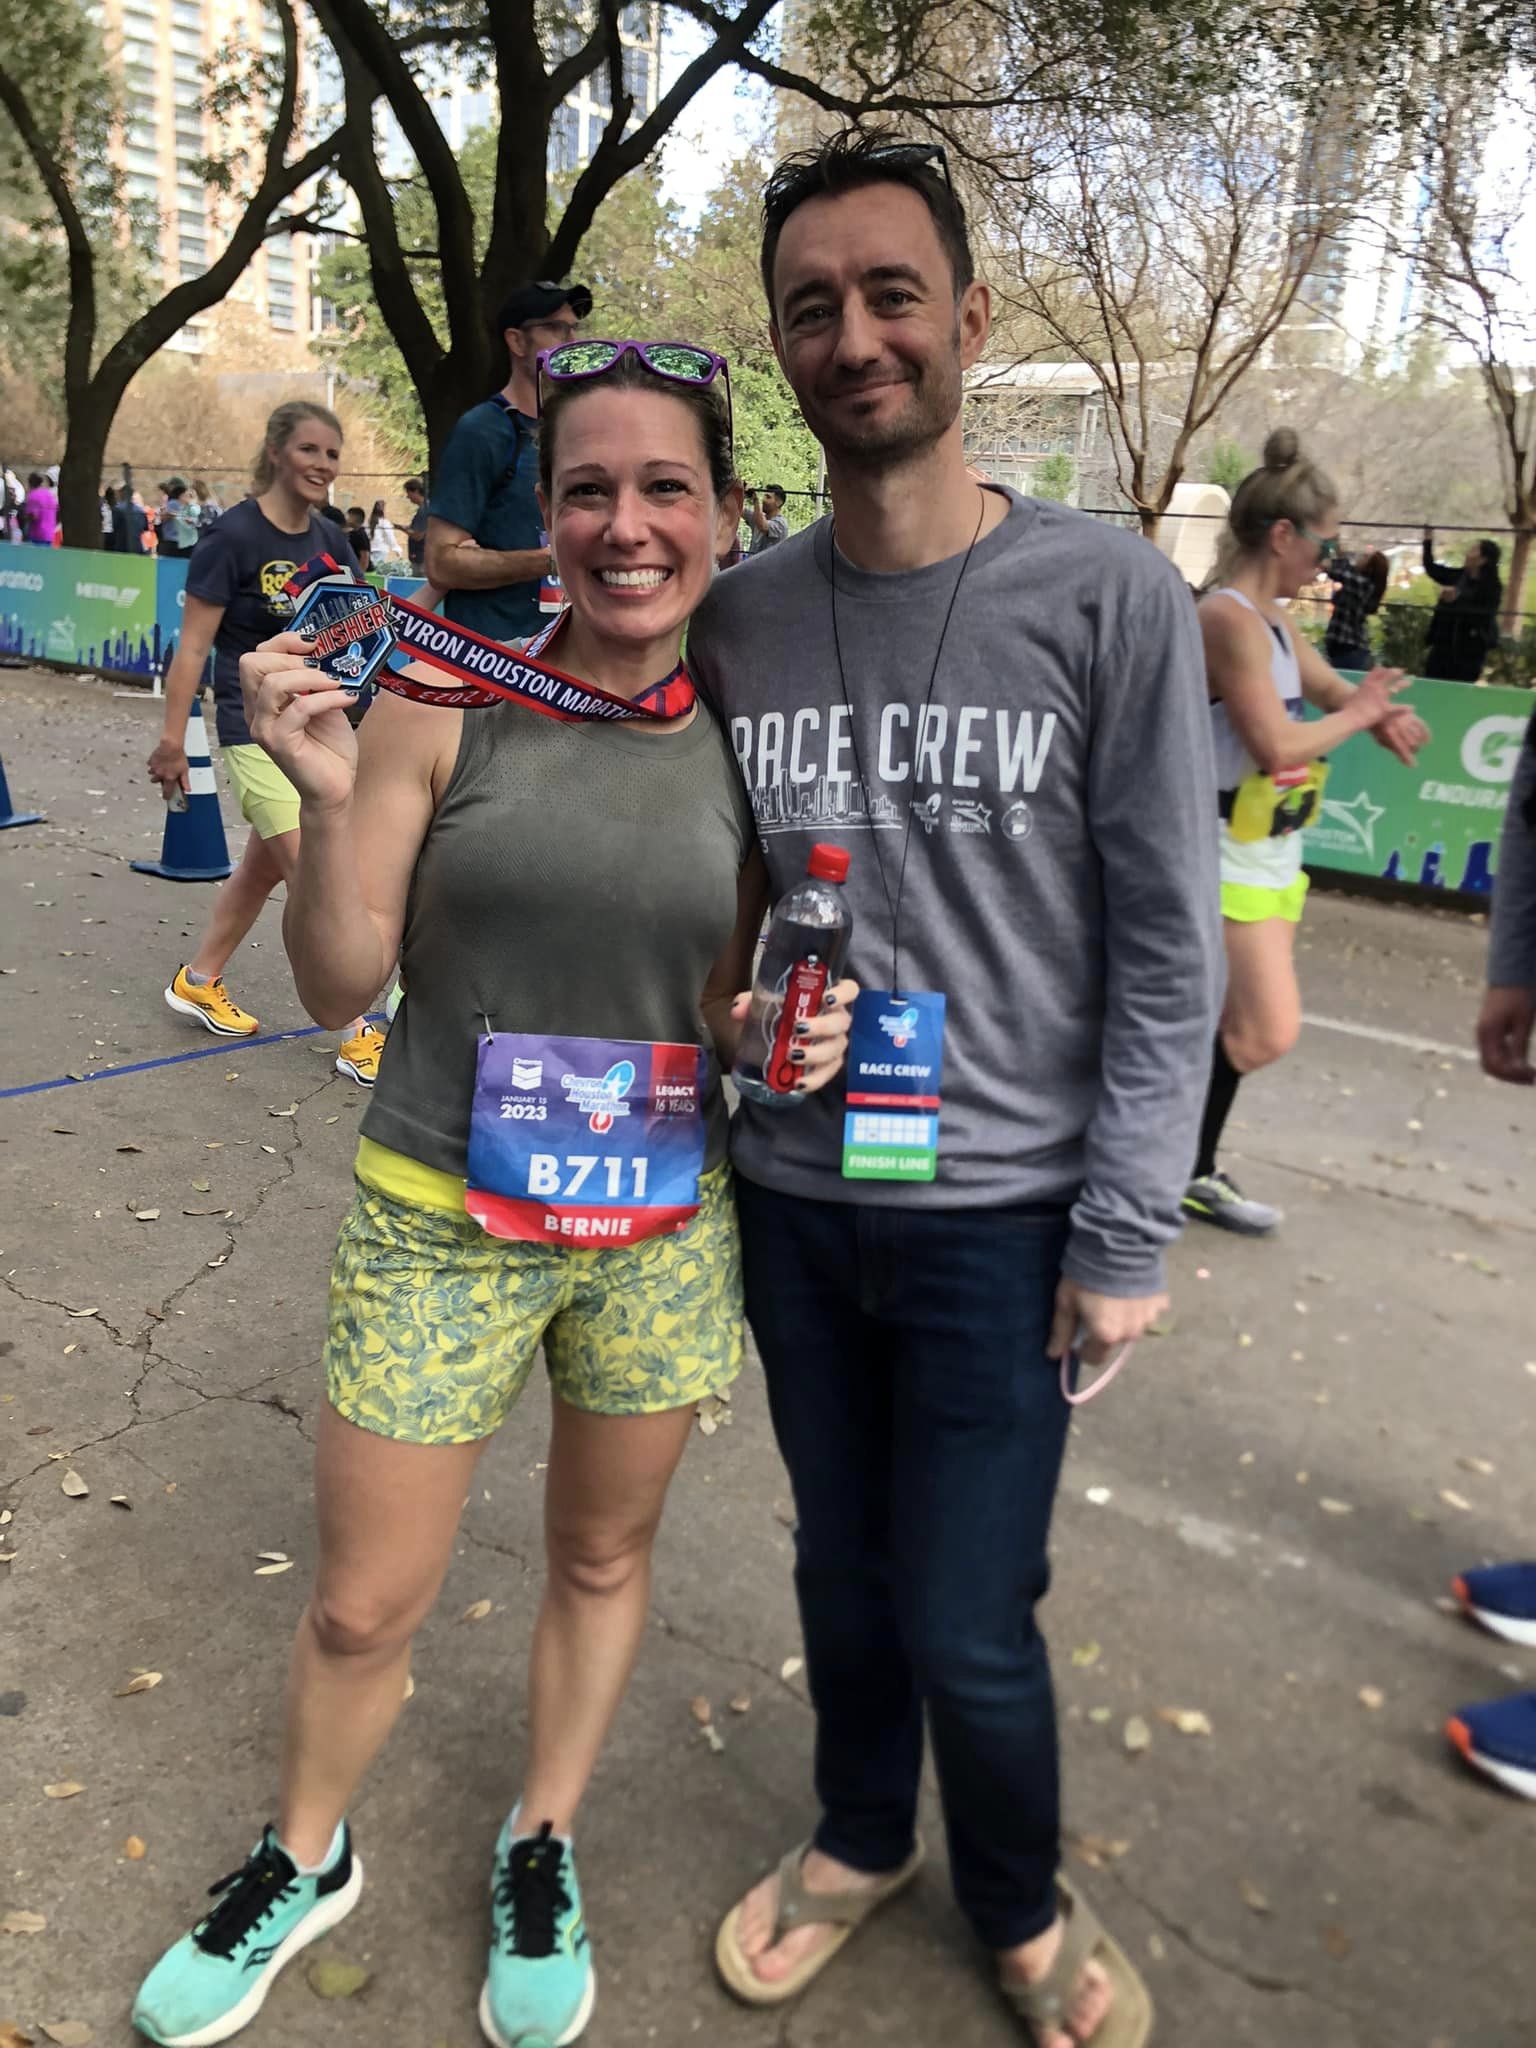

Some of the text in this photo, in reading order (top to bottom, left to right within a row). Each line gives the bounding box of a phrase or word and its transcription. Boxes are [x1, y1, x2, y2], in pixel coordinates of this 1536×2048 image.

[352, 595, 371, 610] 26.2
[312, 602, 390, 659] NISHER
[462, 644, 562, 700] HOUSTON
[731, 703, 1057, 792] RACE CREW
[859, 1062, 931, 1078] RACE CREW
[655, 1085, 695, 1096] LEGACY
[500, 1104, 548, 1120] 2023
[655, 1099, 695, 1113] 16 YEARS
[848, 1155, 897, 1169] FINISH
[528, 1154, 648, 1198] B711
[545, 1215, 632, 1236] BERNIE
